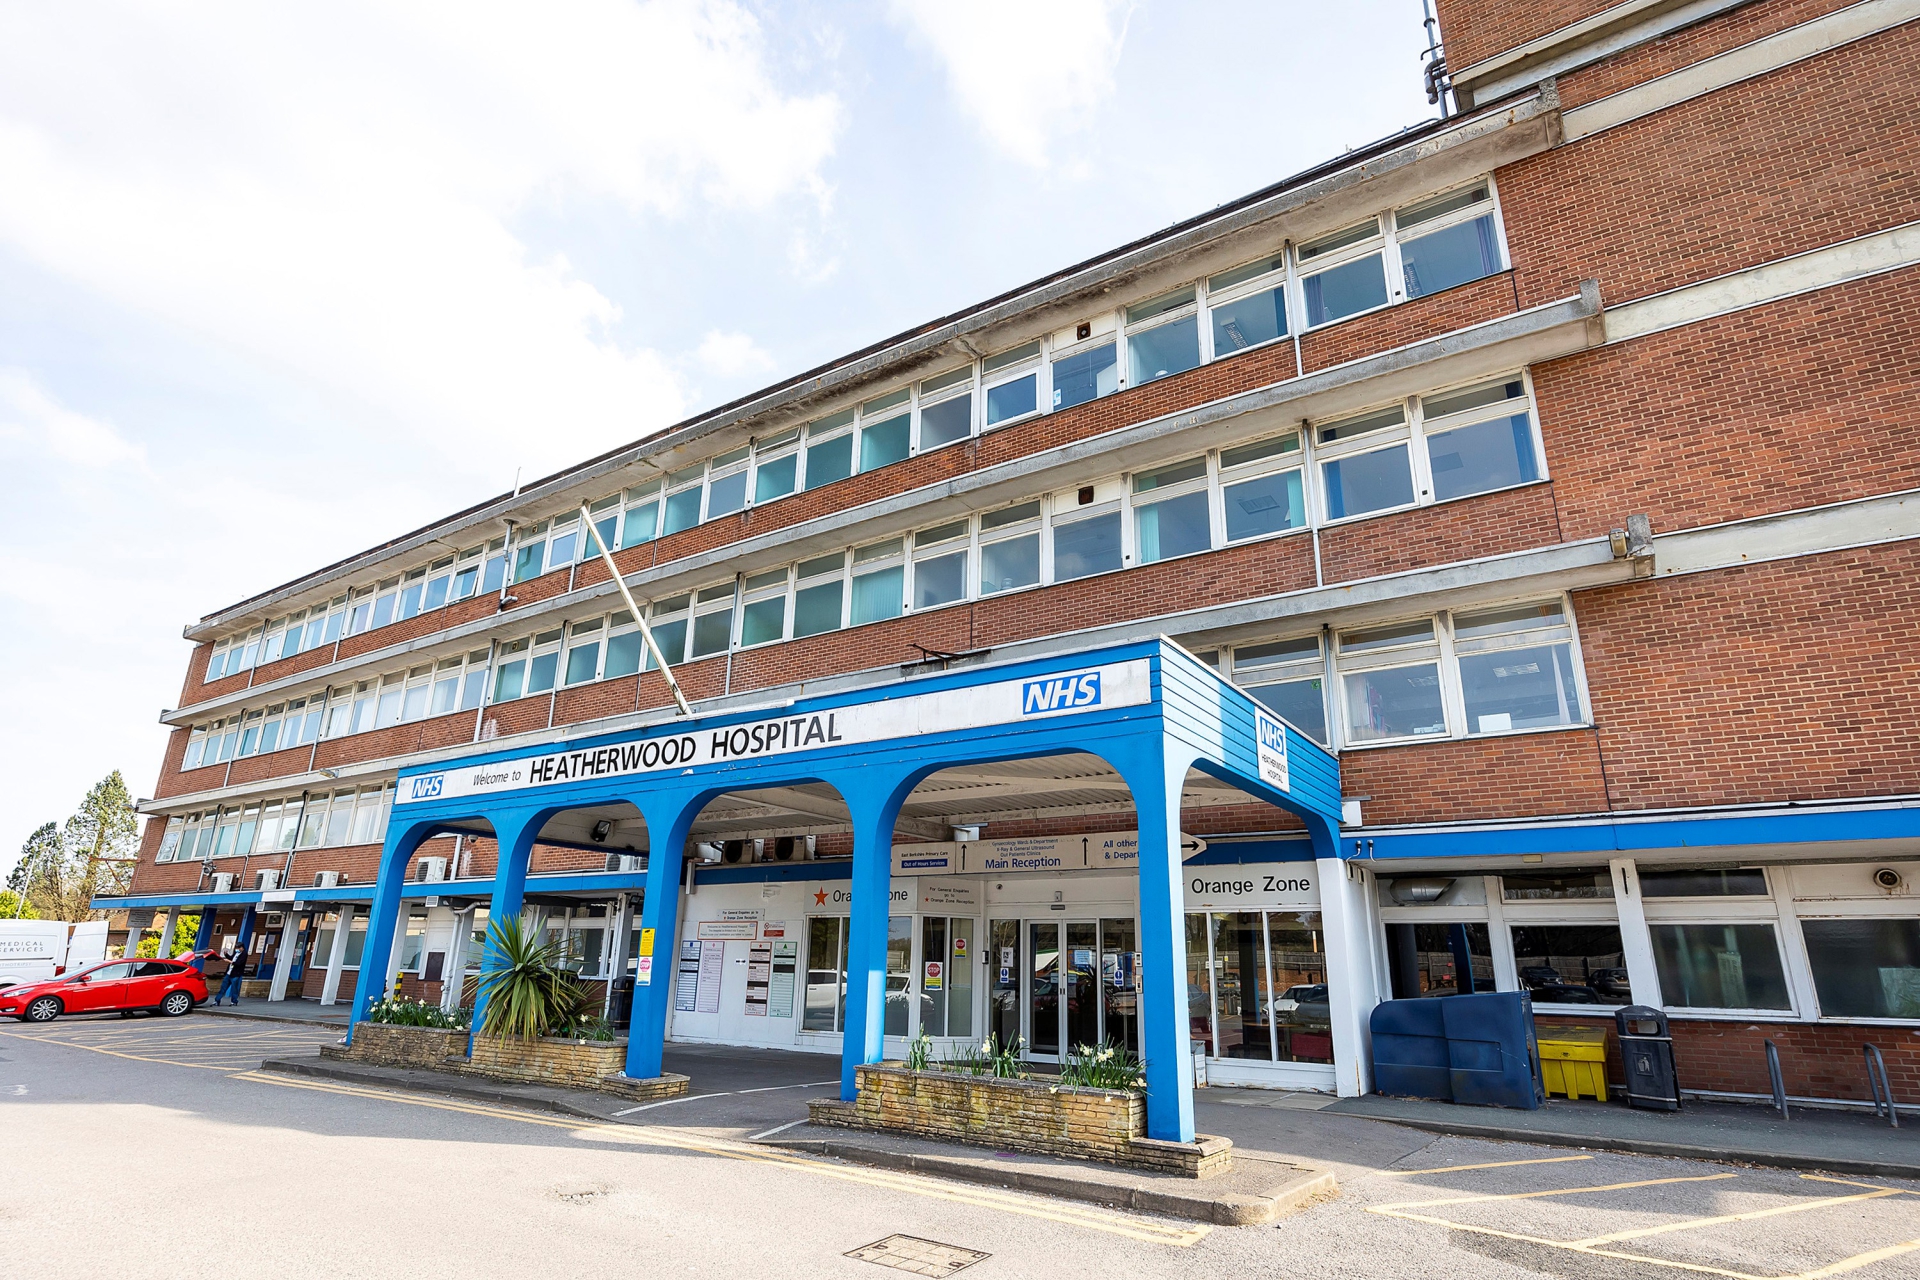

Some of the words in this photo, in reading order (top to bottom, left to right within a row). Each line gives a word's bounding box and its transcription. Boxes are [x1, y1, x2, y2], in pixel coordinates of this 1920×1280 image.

[1025, 674, 1098, 712] NHS
[1261, 718, 1284, 754] NHS
[412, 776, 442, 798] NHS
[473, 772, 509, 786] Welcome
[512, 771, 521, 782] to
[529, 736, 696, 784] HEATHERWOOD
[710, 713, 842, 759] HOSPITAL
[1262, 753, 1287, 774] HEATHERWOOD
[1267, 769, 1284, 784] HOSPITAL
[1103, 840, 1114, 848] All
[1116, 839, 1138, 848] other
[986, 858, 1009, 869] Main
[1012, 856, 1061, 870] Reception
[1104, 851, 1111, 860] &
[1113, 850, 1140, 860] Depart
[1191, 878, 1254, 895] Orange
[1262, 876, 1311, 892] Zone
[833, 890, 852, 902] Ora
[889, 891, 908, 901] one
